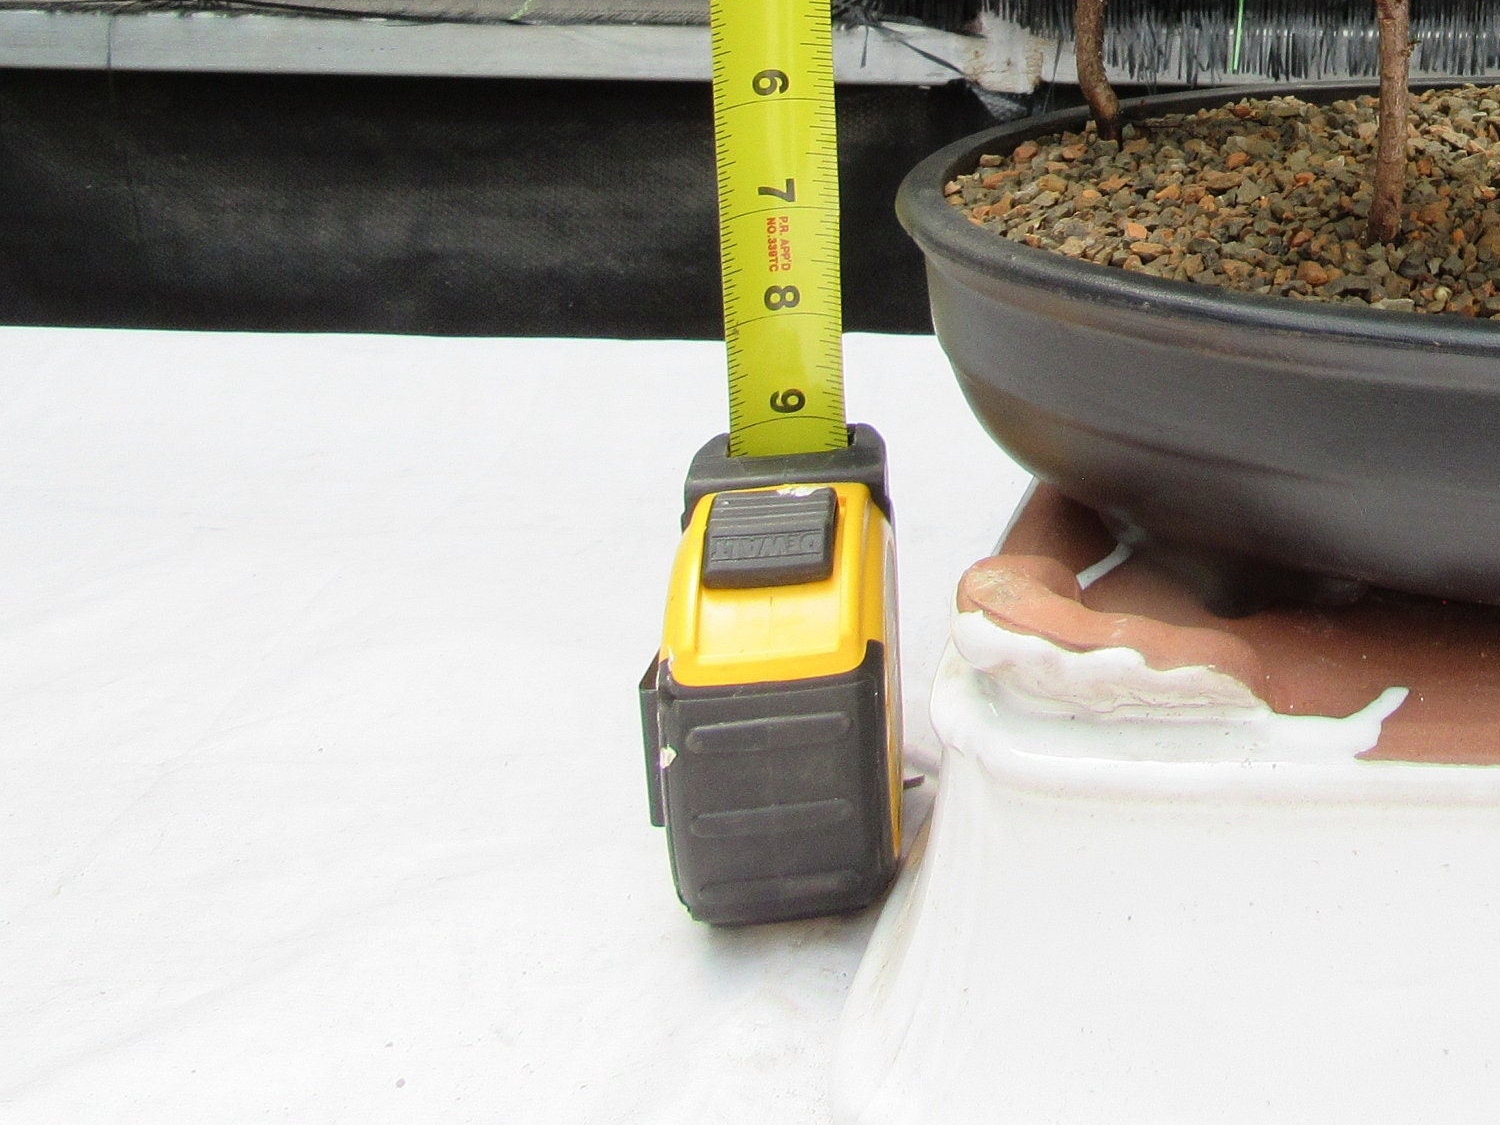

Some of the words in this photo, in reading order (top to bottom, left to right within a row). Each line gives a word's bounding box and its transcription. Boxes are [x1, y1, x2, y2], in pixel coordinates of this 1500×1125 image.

[752, 69, 789, 96] 6
[758, 178, 796, 203] 7
[764, 285, 800, 311] 8
[770, 389, 805, 413] 9
[712, 532, 819, 559] DEWALT
